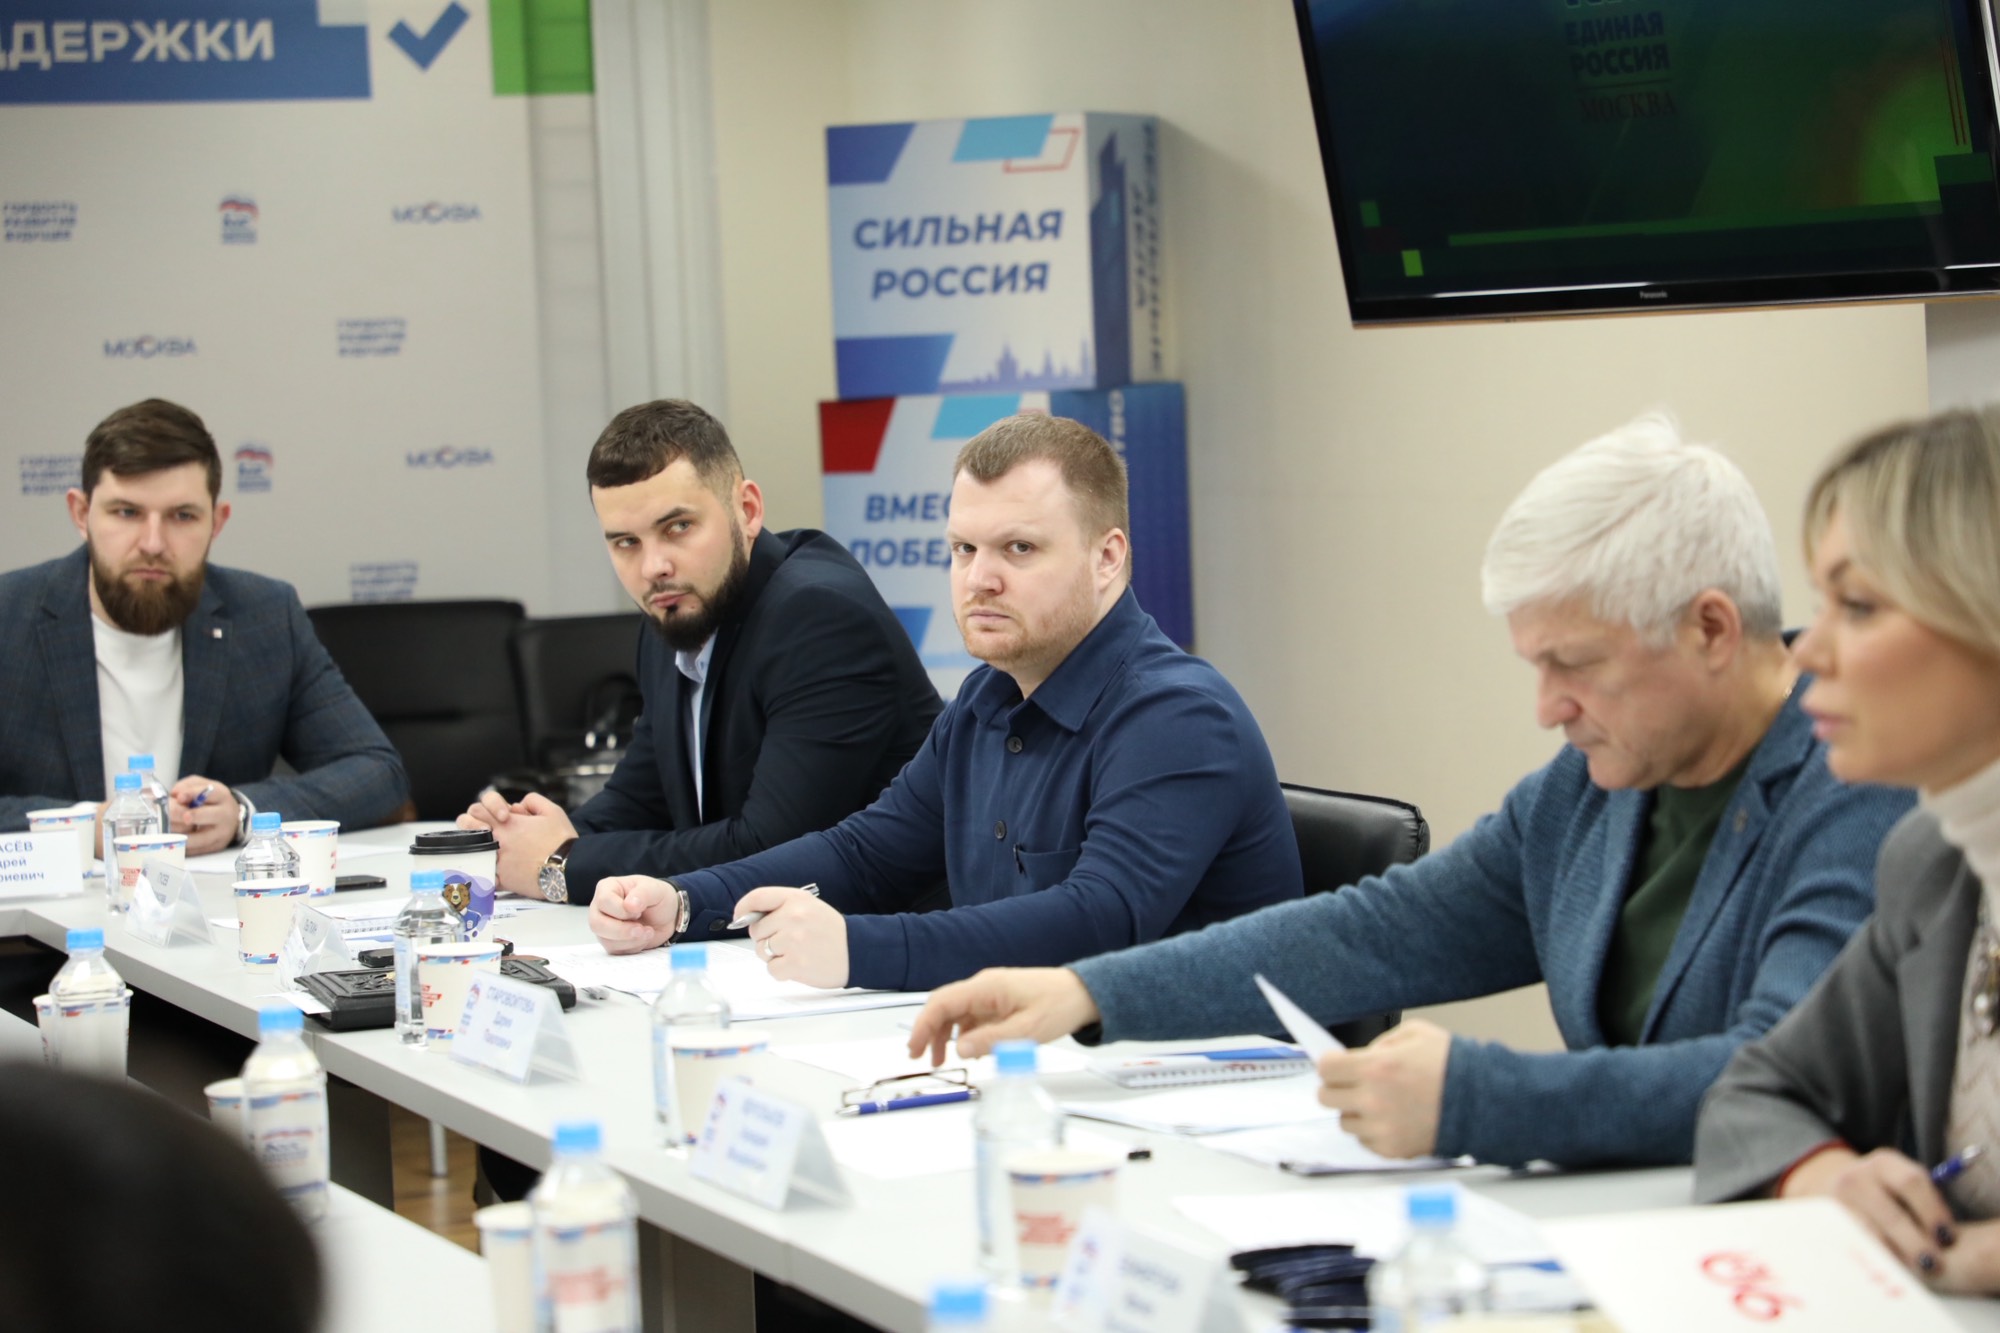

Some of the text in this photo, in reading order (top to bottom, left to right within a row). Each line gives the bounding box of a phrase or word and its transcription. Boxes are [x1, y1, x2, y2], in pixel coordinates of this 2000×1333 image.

[0, 19, 275, 71] ДЕРЖКИ
[1565, 9, 1664, 48] ЕДИНАЯ
[1569, 42, 1670, 79] РОССИЯ
[1577, 91, 1677, 121] МОСКВА
[853, 209, 1064, 249] СИЛЬНАЯ
[872, 261, 1048, 300] РОССИЯ
